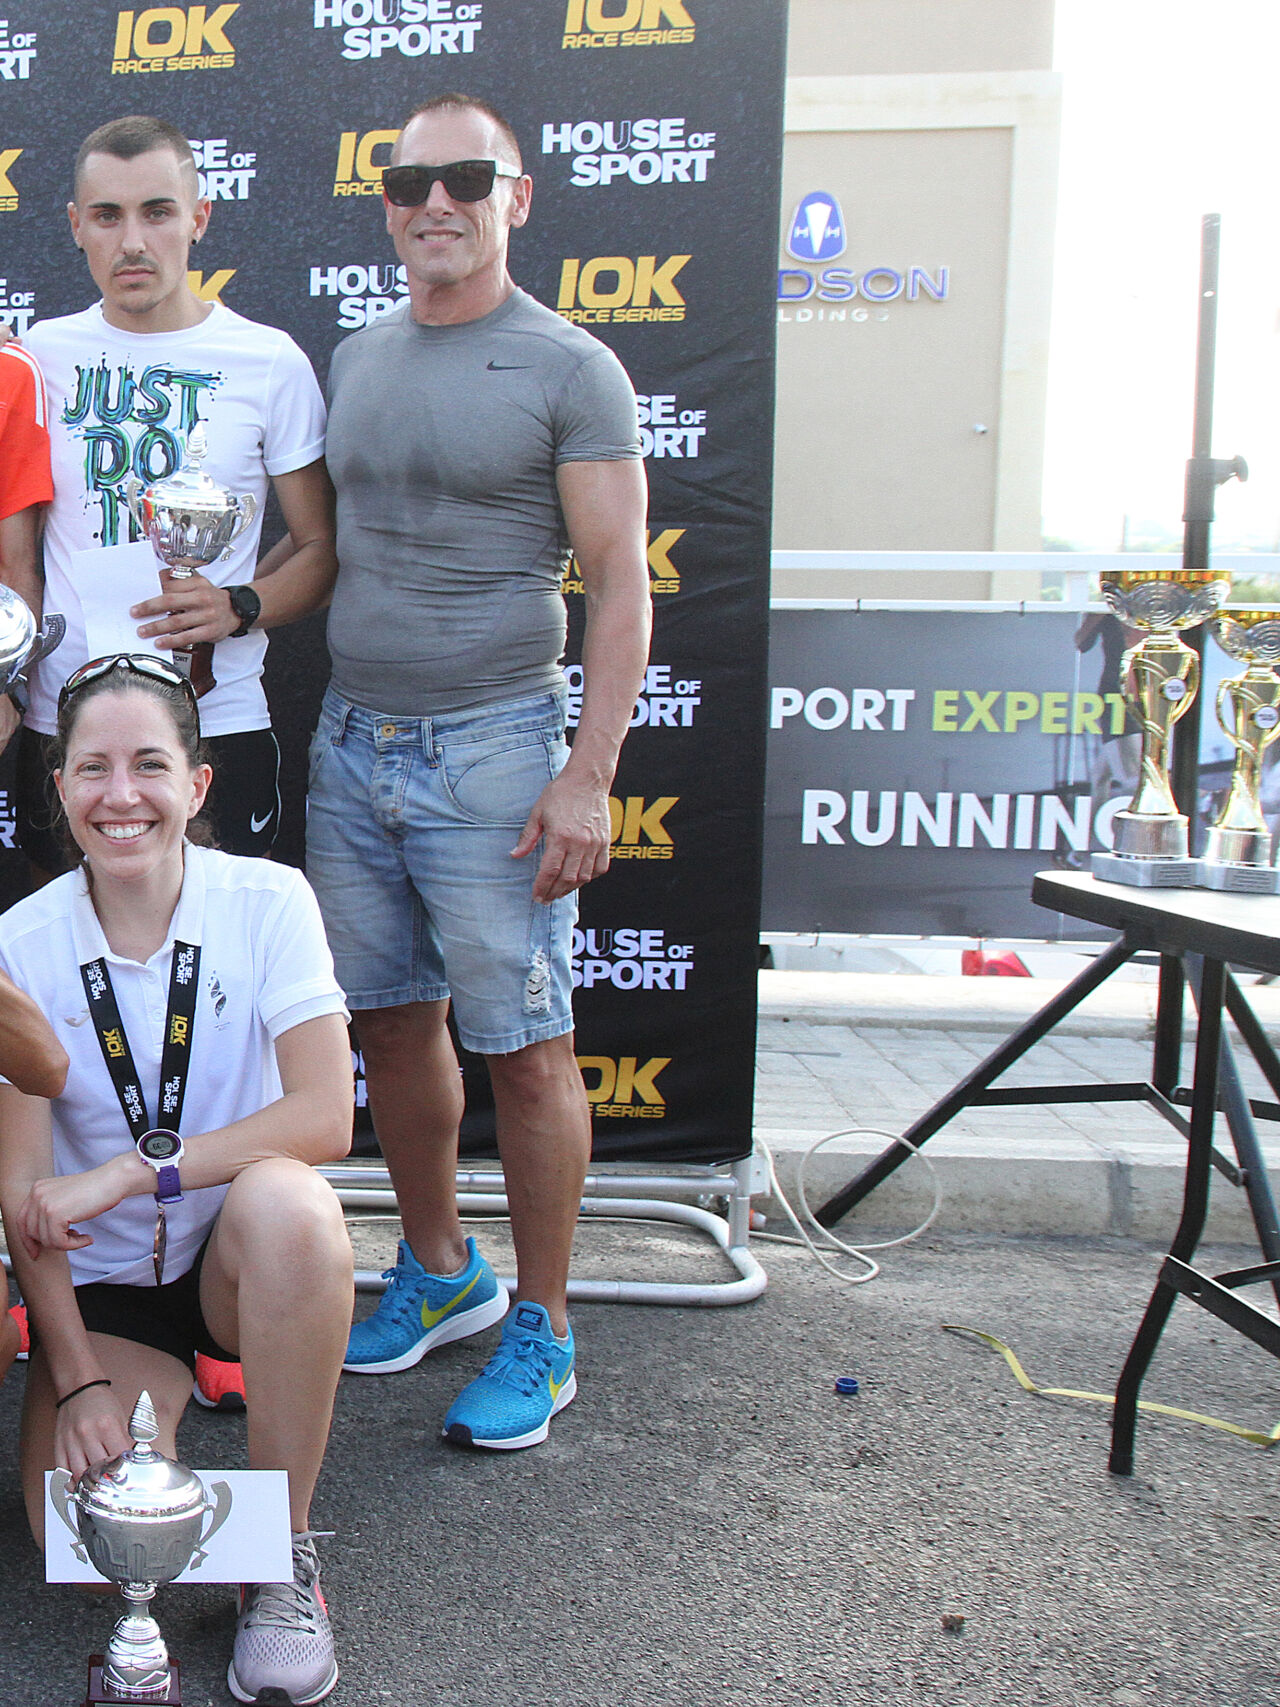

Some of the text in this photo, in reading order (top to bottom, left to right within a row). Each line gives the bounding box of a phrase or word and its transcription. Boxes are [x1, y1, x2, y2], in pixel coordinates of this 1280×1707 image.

[314, 0, 481, 28] HOUSE OF
[564, 0, 696, 29] 10K
[13, 33, 37, 49] OF
[113, 3, 242, 60] 10K
[341, 22, 481, 61] SPORT
[562, 27, 695, 49] RACE SERIES
[112, 51, 235, 75] RACE SERIES
[541, 118, 716, 154] HOUSE OF
[231, 153, 256, 168] OF
[335, 129, 403, 181] 10
[570, 150, 716, 187] SPORT
[309, 265, 409, 296] HOUS
[558, 254, 693, 308] 10K
[10, 292, 35, 307] OF
[556, 306, 686, 324] RACE SERIES
[61, 363, 221, 430] JUST
[679, 409, 706, 425] OF
[82, 424, 182, 491] DO
[674, 679, 701, 694] OF
[769, 687, 1133, 735] PORT EXPERT
[801, 789, 1134, 851] RUNNIN
[668, 945, 694, 959] OF
[176, 952, 187, 985] SPORT
[103, 1030, 122, 1058] 10K
[174, 1015, 188, 1047] 10K
[575, 1056, 672, 1104] 0K
[129, 1085, 143, 1115] SPORT
[163, 1082, 172, 1113] SPORT
[596, 1105, 665, 1118] SERIES
